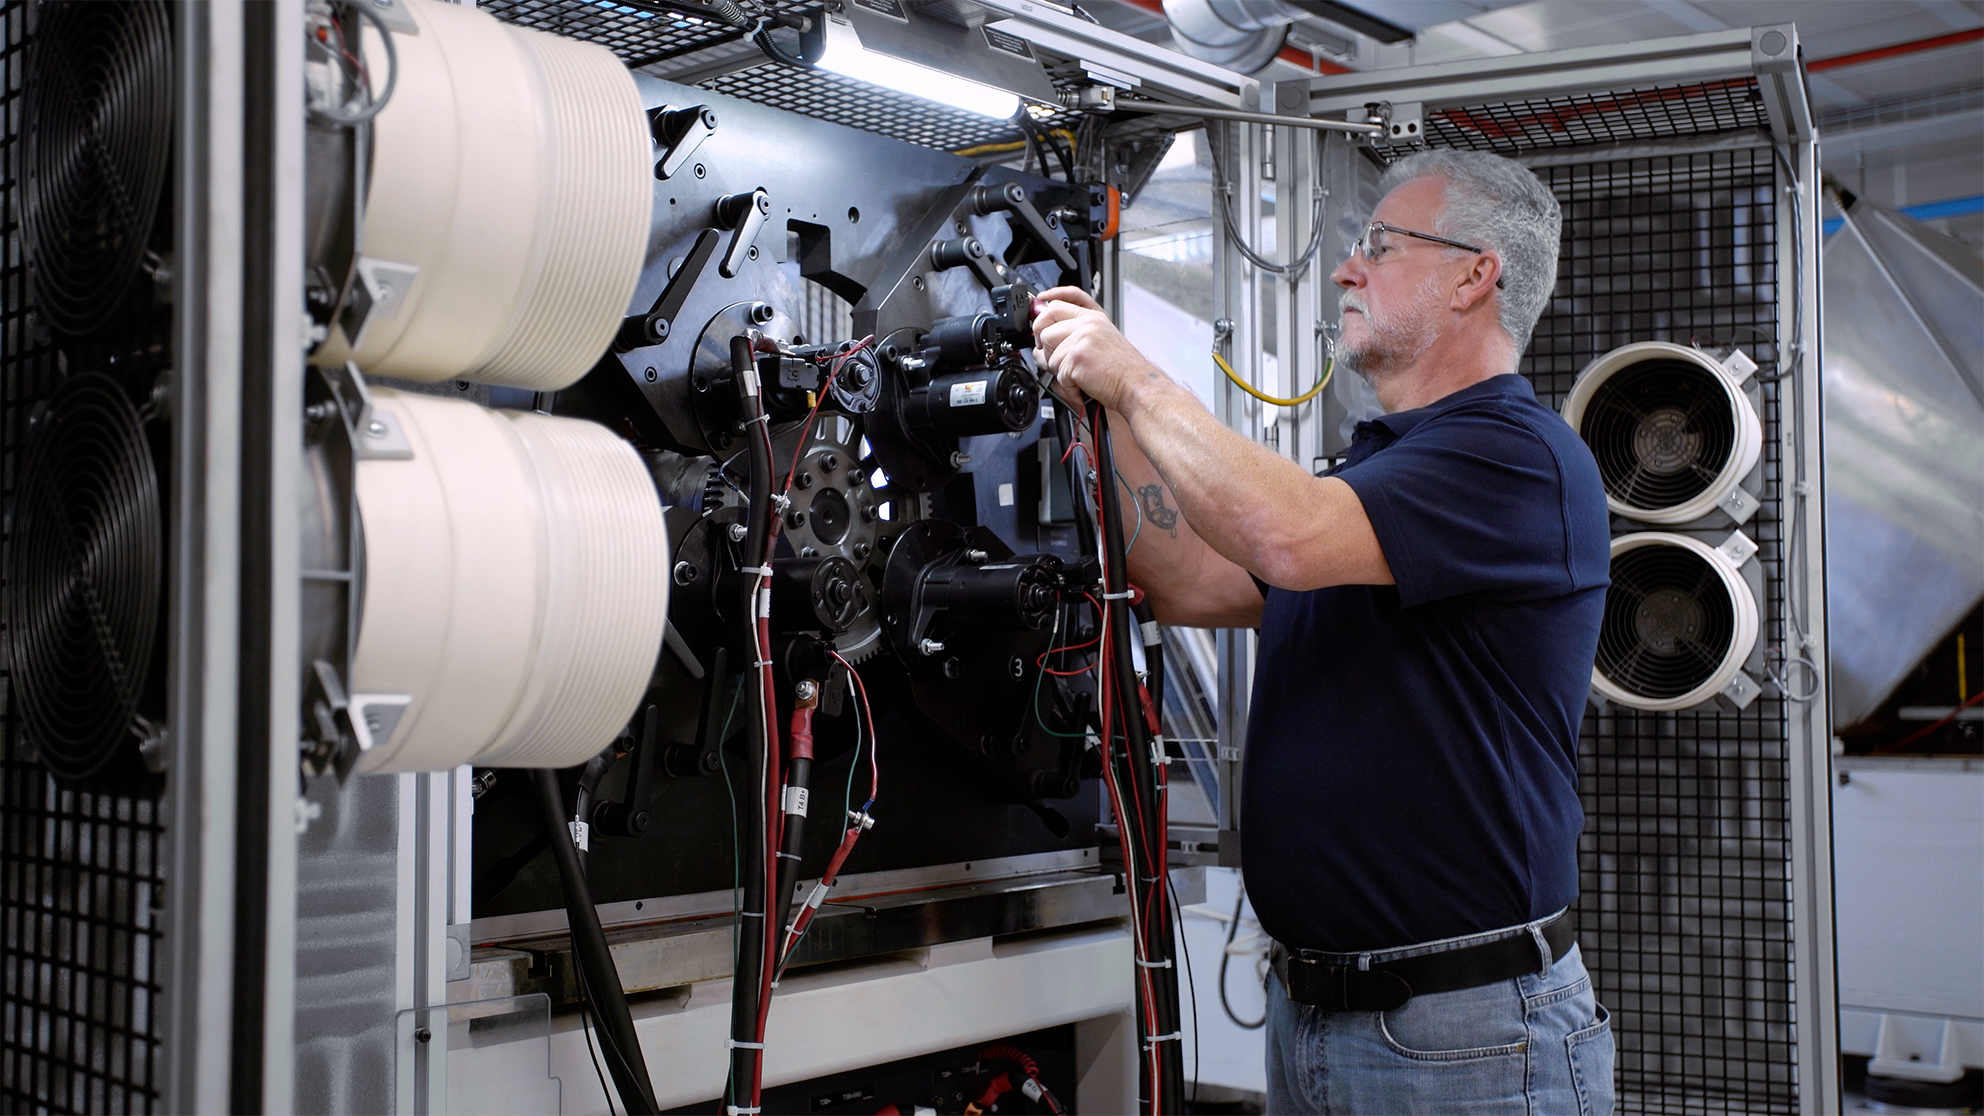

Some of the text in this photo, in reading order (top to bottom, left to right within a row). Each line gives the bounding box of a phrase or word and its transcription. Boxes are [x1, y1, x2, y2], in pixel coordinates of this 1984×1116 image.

[1014, 658, 1023, 677] 3
[797, 790, 805, 810] T4 B+
